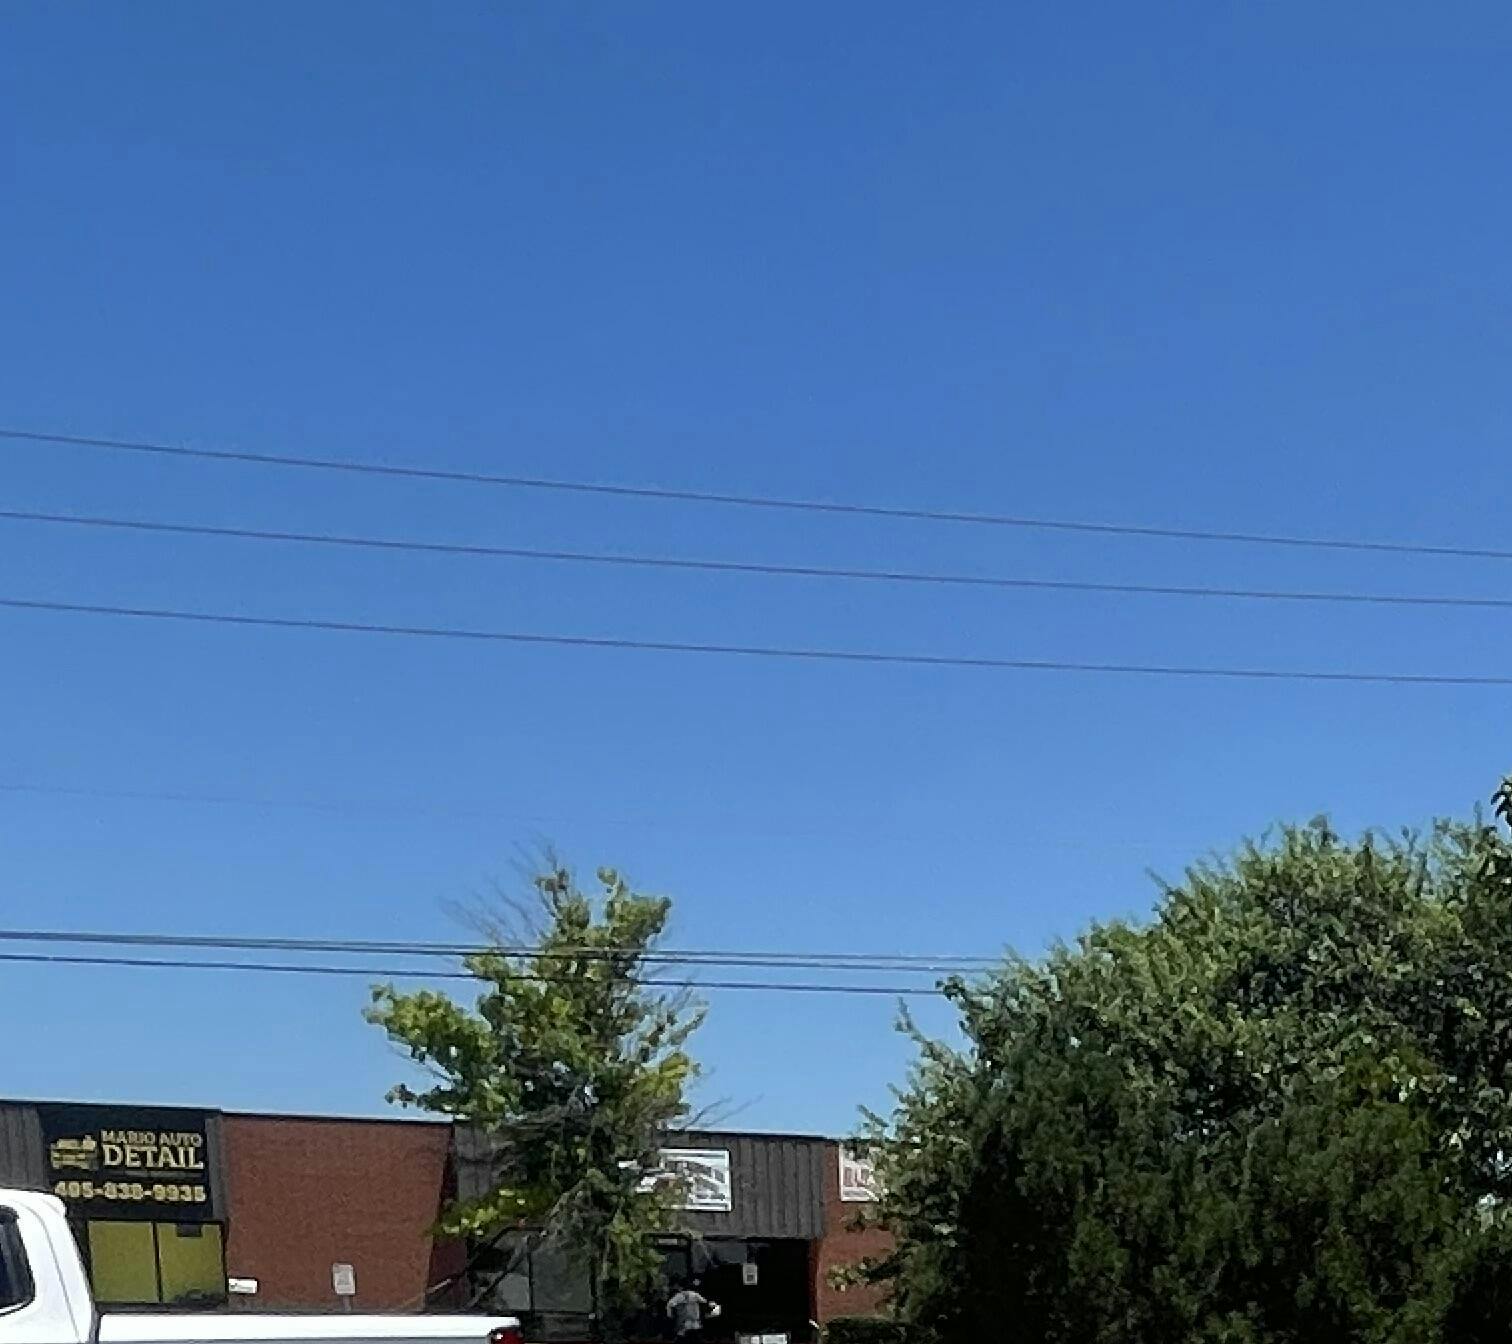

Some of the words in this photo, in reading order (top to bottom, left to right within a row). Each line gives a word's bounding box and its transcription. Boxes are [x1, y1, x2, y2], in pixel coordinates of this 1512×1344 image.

[101, 1130, 155, 1145] MARIO
[160, 1132, 202, 1148] AUTO
[102, 1145, 204, 1170] DETAIL
